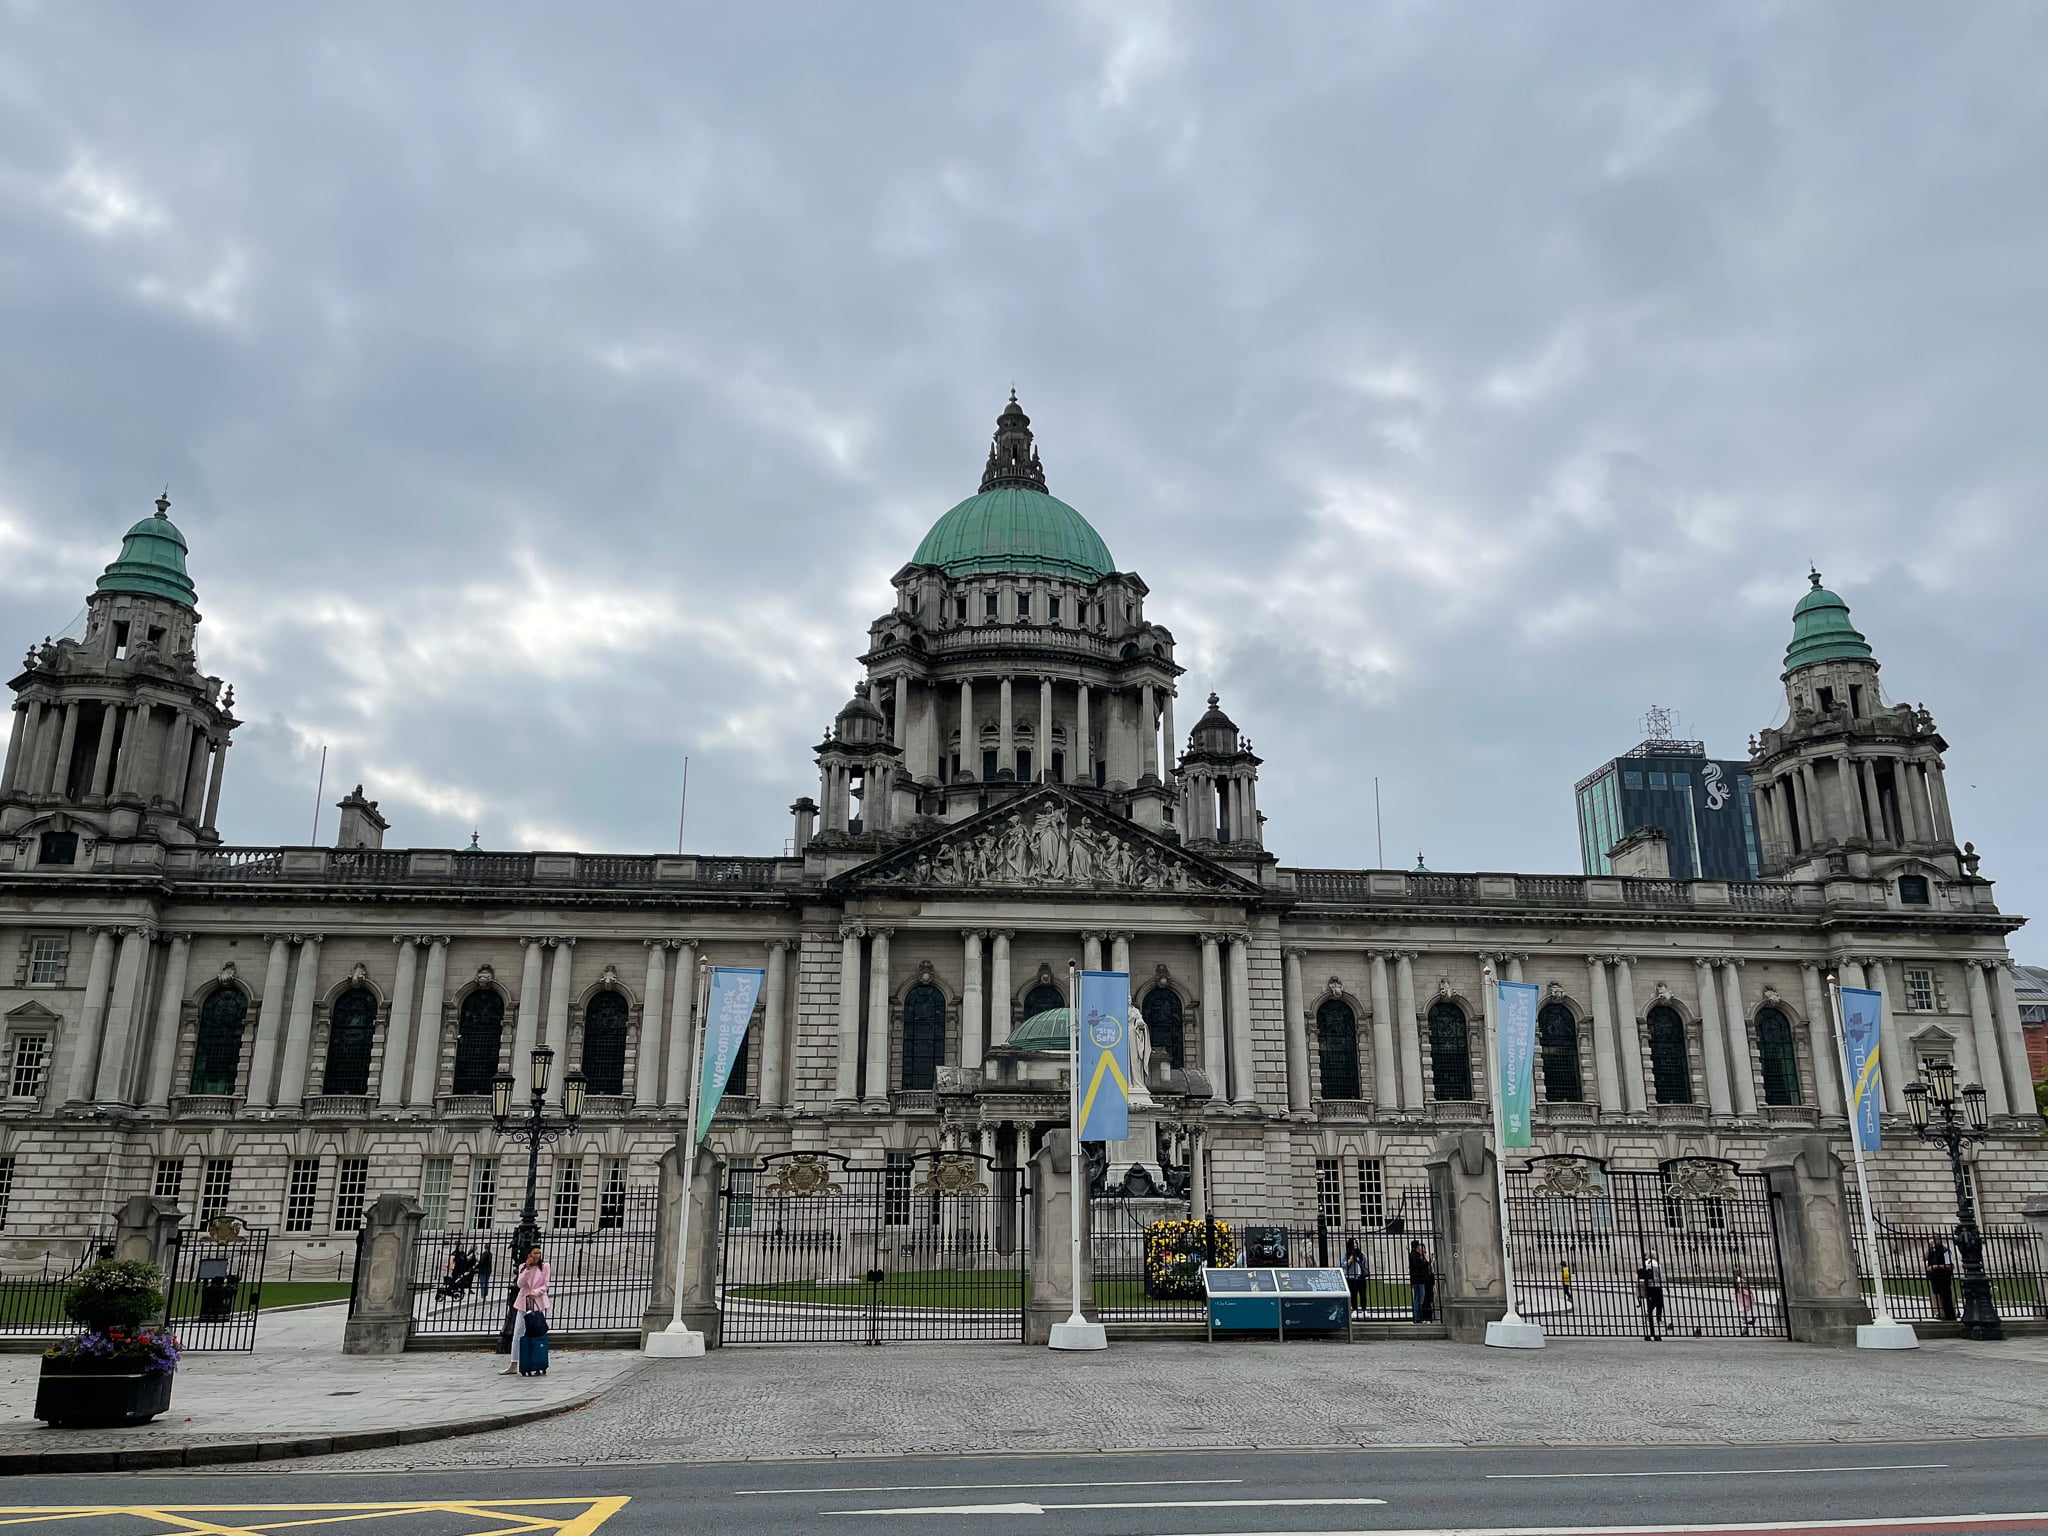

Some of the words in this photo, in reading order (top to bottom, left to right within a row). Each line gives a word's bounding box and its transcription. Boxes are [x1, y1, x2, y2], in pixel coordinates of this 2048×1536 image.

[1575, 775, 1591, 792] GRAND
[1591, 761, 1614, 781] CENTRAL
[719, 989, 736, 1021] Back
[731, 976, 752, 1031] Belfast
[1516, 991, 1529, 1046] Belfast
[1096, 1034, 1116, 1042] Safe
[1097, 1027, 1116, 1036] Stay
[712, 1025, 730, 1088] Welcome
[1507, 1035, 1517, 1097] Welcome
